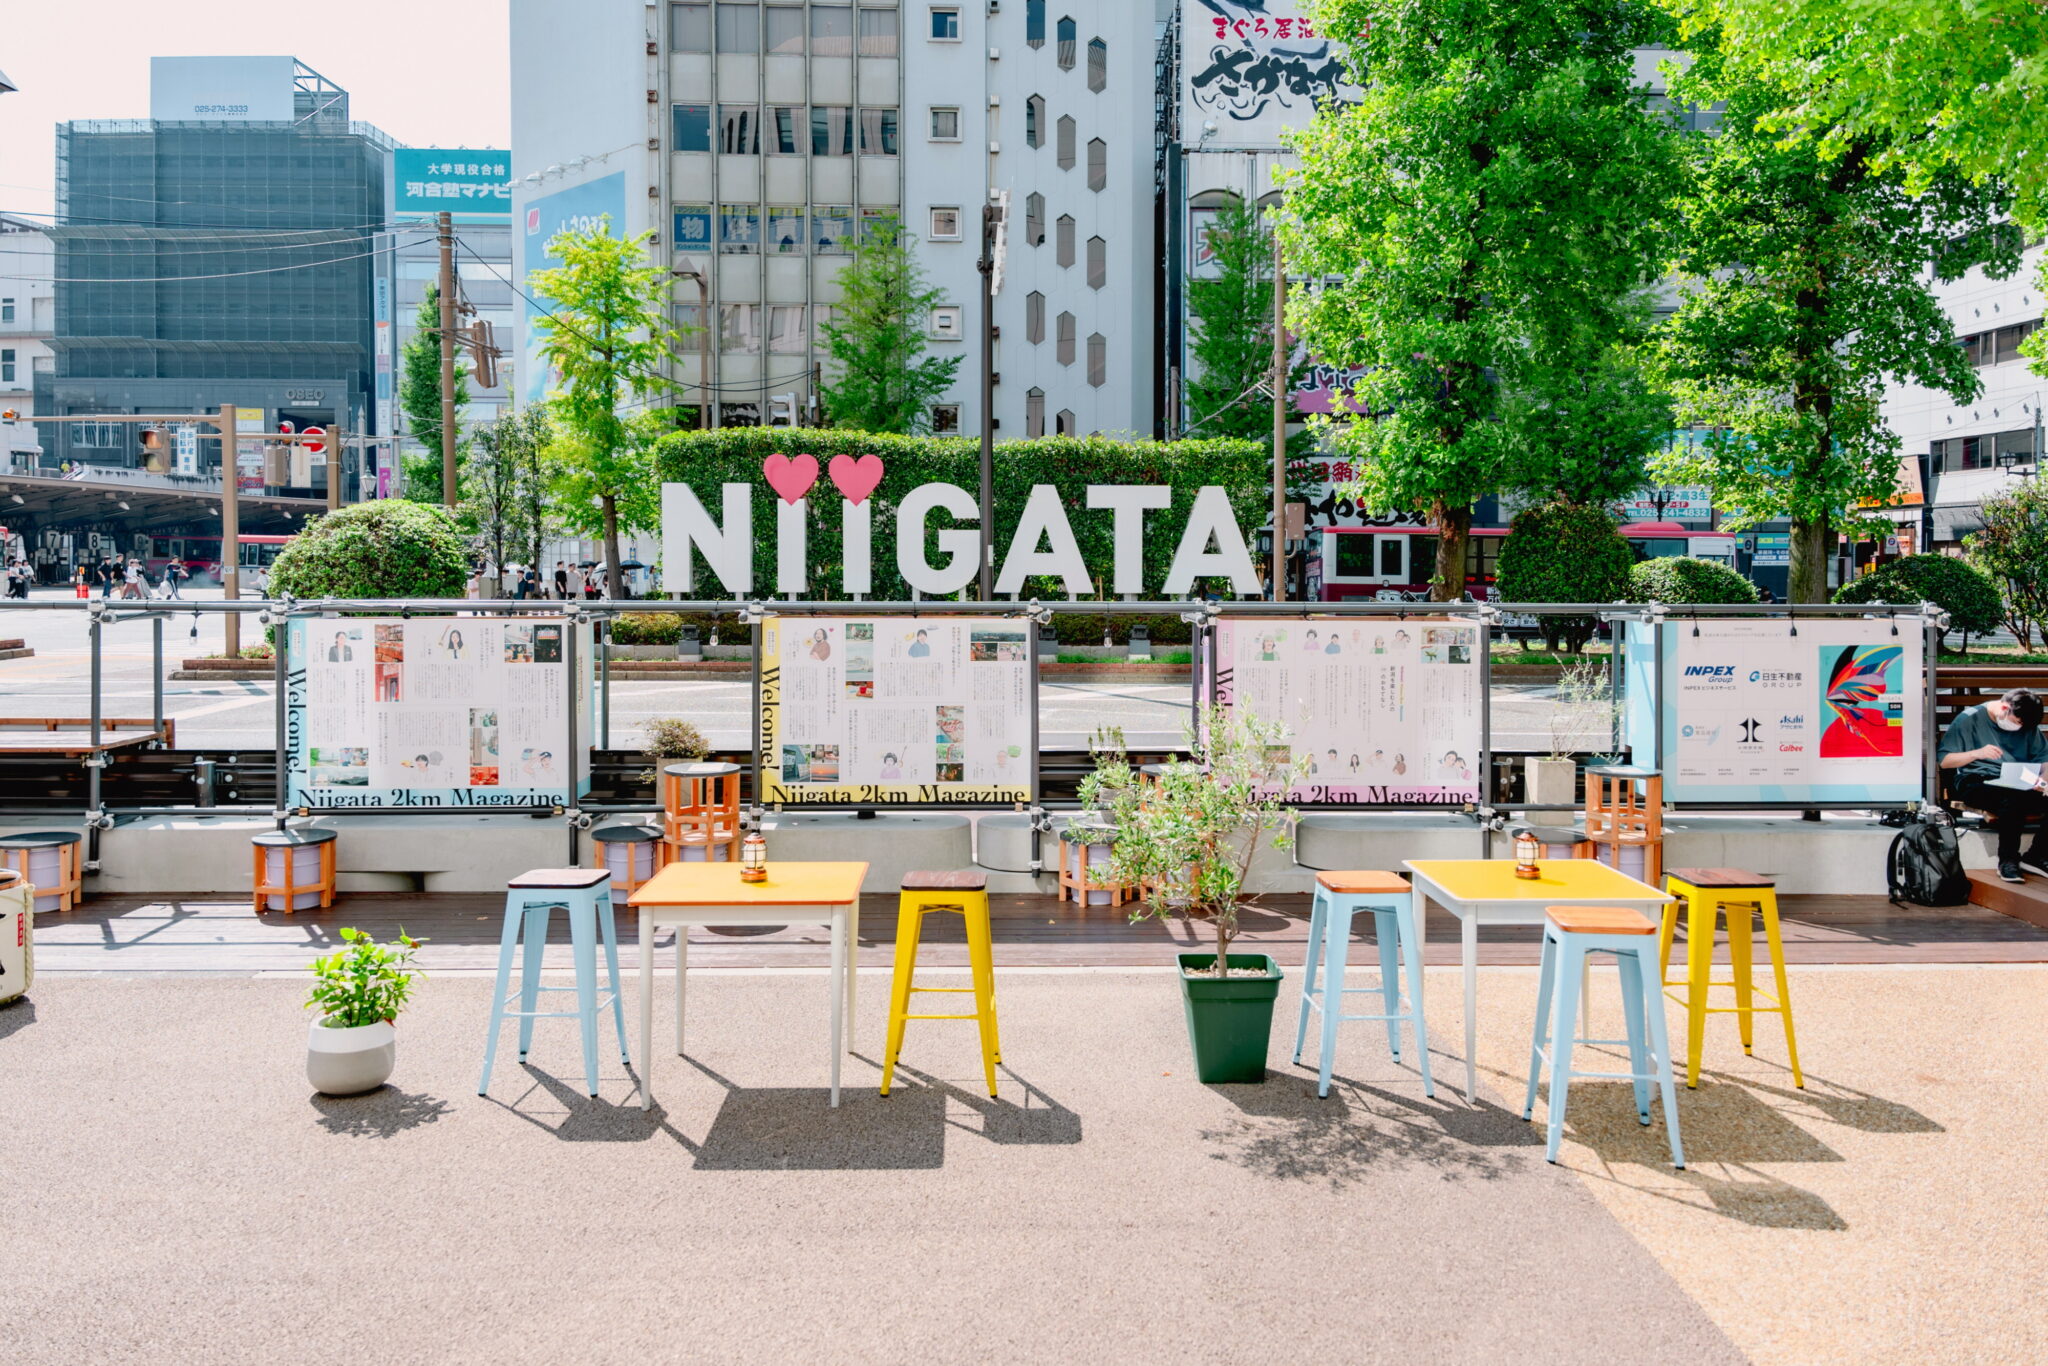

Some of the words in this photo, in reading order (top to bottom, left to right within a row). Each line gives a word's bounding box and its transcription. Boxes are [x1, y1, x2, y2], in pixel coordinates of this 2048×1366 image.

[194, 105, 249, 113] 025-274-3333
[427, 163, 506, 176] 大学現役合格
[406, 181, 511, 199] 河合塾マナビ
[661, 453, 1265, 594] NIIGATA
[50, 533, 57, 548] 7
[92, 534, 98, 548] 8
[1684, 666, 1736, 676] INPEX
[1762, 672, 1802, 681] 日生不動産
[288, 667, 307, 774] Welcome!
[762, 666, 780, 771] Welcome!
[1780, 715, 1803, 724] Asahi
[1779, 744, 1803, 752] Calbee
[297, 788, 383, 808] Niigata
[391, 788, 441, 807] 2km
[452, 788, 563, 806] Magazine
[770, 785, 851, 803] Niigata
[860, 785, 908, 803] 2km
[918, 785, 1025, 803] Magazine
[1311, 785, 1358, 803] 2km
[1368, 785, 1473, 803] Magazine
